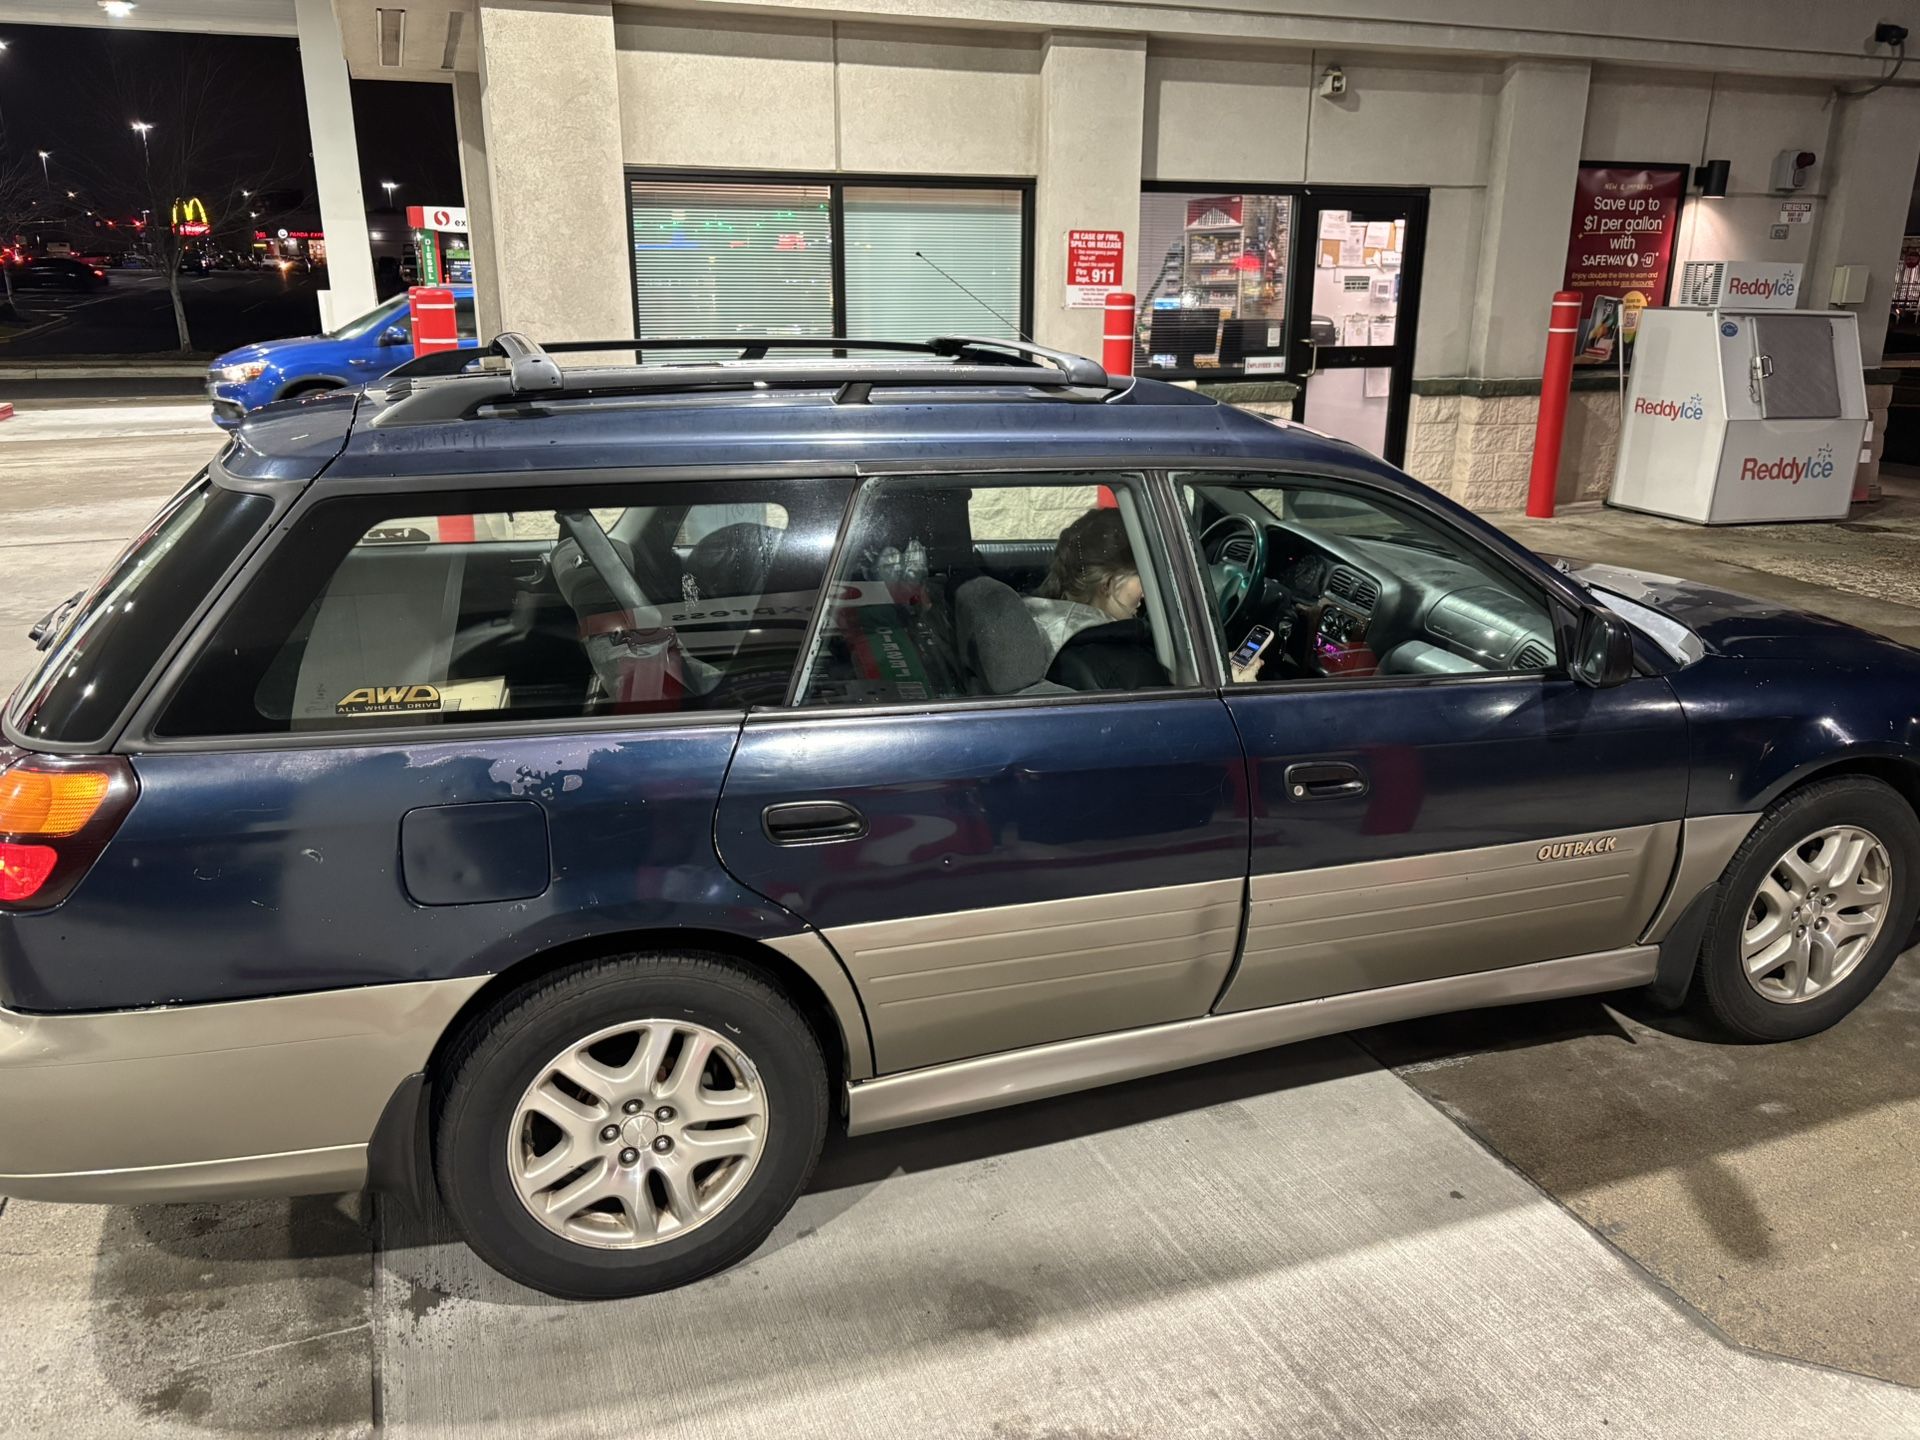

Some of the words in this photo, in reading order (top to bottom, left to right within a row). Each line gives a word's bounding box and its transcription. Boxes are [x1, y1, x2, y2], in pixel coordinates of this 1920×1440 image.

[1594, 196, 1626, 211] Save
[1628, 199, 1645, 215] up
[1648, 197, 1660, 211] to
[1584, 215, 1598, 231] $1
[1600, 218, 1623, 235] per
[1073, 232, 1080, 240] IN
[1610, 234, 1636, 250] with
[1070, 240, 1087, 248] SPILL
[1096, 241, 1122, 249] RELEASE
[425, 239, 434, 279] DIESEL
[1581, 254, 1627, 266] SAFEWAY
[1091, 268, 1115, 283] 911
[336, 685, 441, 706] AWD
[338, 705, 359, 713] ALL
[1537, 836, 1617, 861] OUTBACK
